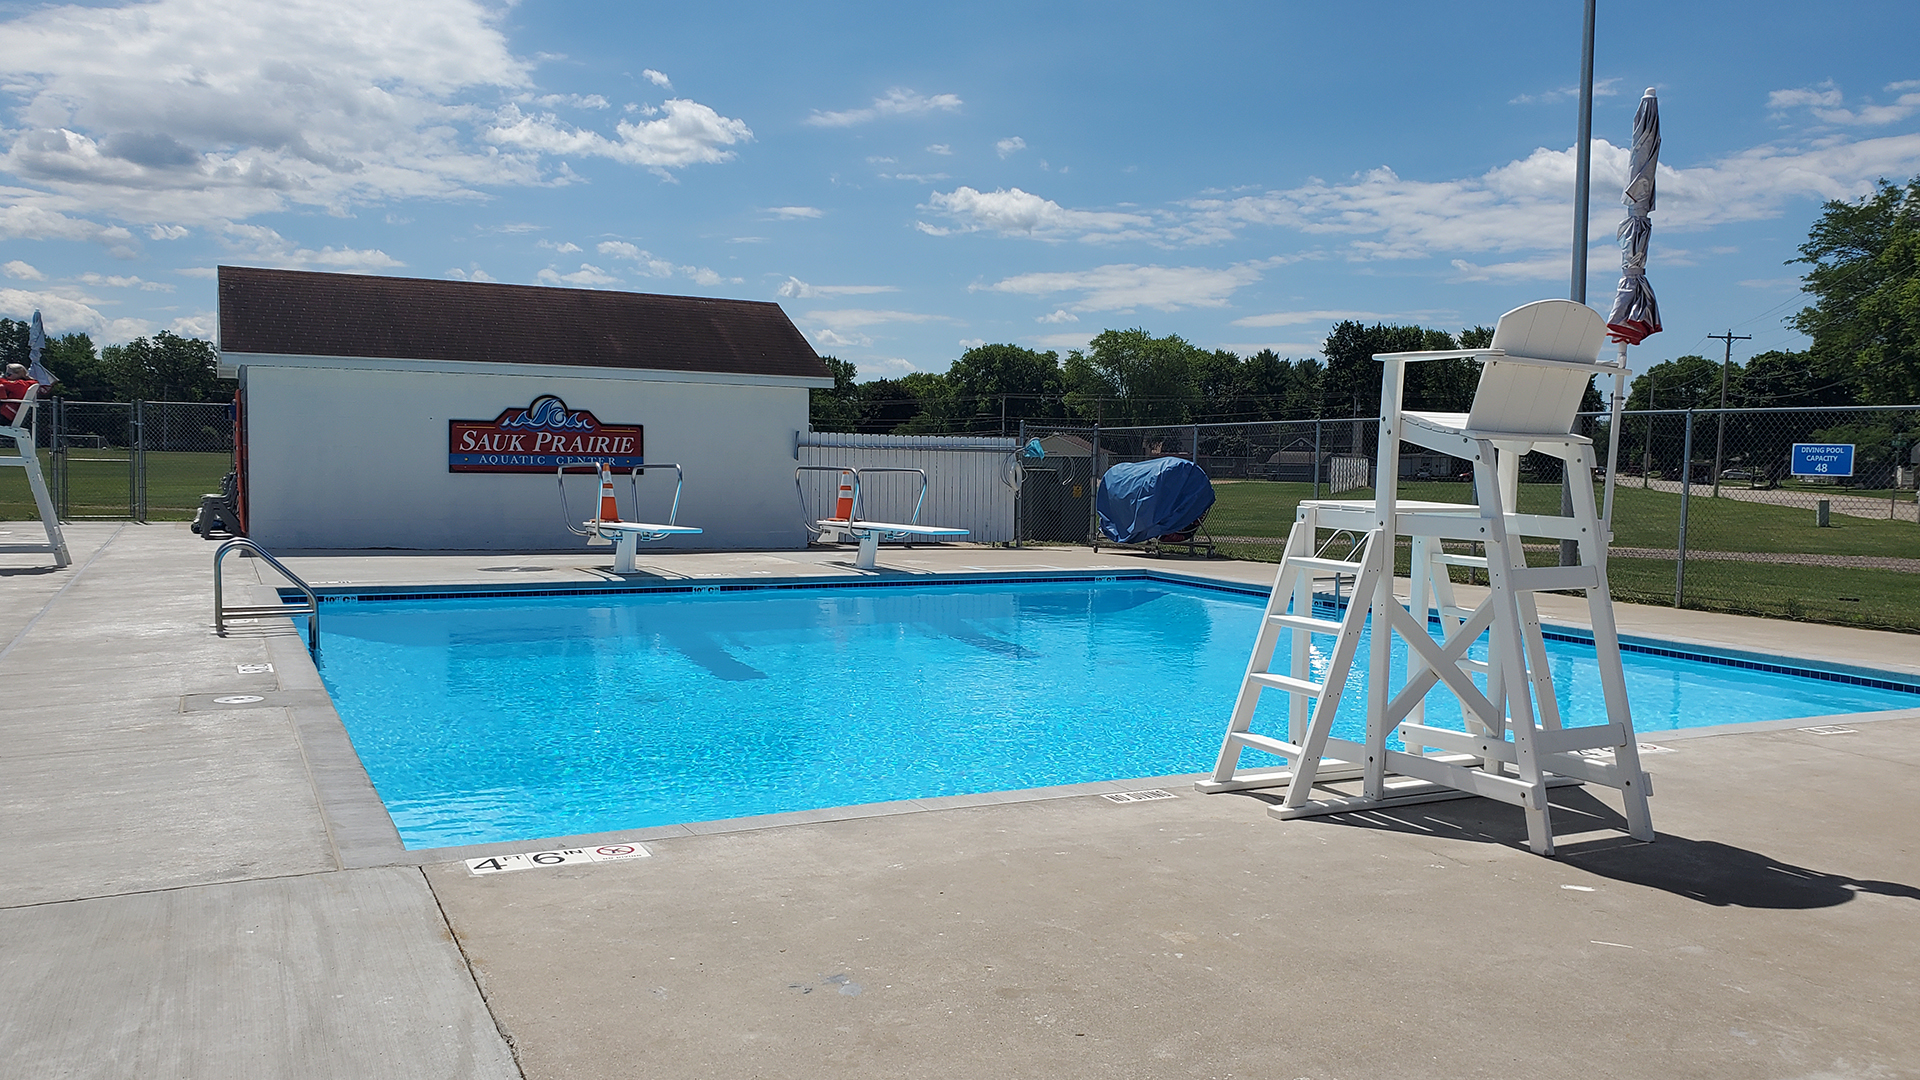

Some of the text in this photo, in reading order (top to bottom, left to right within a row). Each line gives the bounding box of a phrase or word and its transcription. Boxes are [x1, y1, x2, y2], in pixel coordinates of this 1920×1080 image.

[459, 430, 635, 454] SAUK PRAIRIE
[478, 455, 616, 465] AQUATIC CENTER
[1814, 463, 1828, 472] 48
[473, 858, 507, 870] 4
[532, 852, 565, 865] 6
